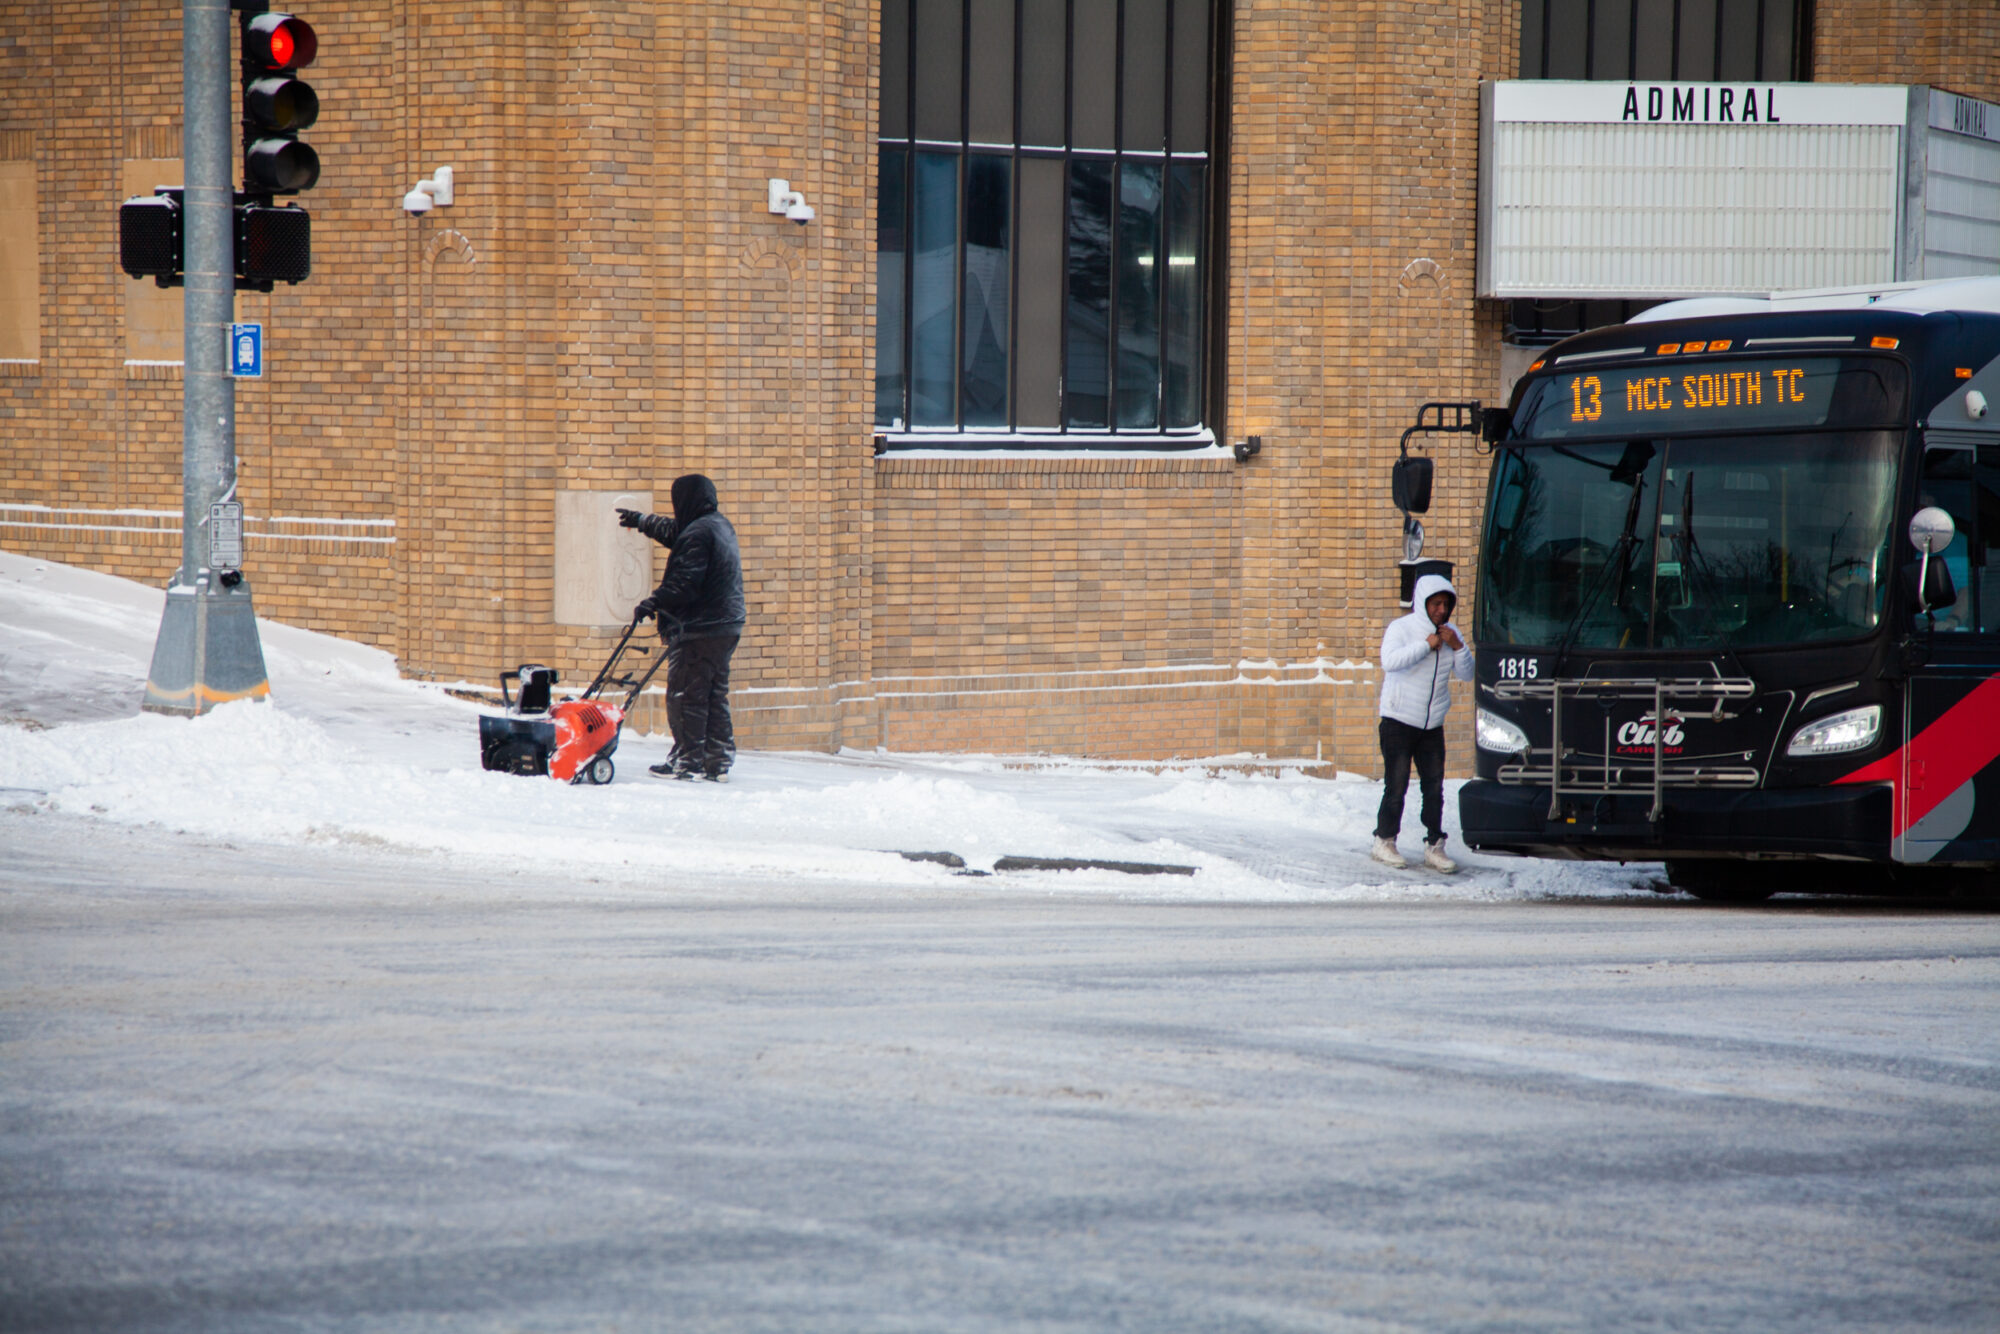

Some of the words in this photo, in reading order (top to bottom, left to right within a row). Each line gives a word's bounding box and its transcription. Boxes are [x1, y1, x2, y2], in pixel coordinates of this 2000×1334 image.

[1622, 86, 1780, 122] ADMIRAL
[1953, 96, 1987, 137] ADMIRAL
[1570, 376, 1602, 421] 13
[1627, 376, 1672, 411] MCC
[1682, 371, 1761, 408] SOUTH
[1772, 368, 1805, 402] TC
[1498, 657, 1538, 679] 1815
[1617, 721, 1685, 746] Club
[1616, 746, 1684, 754] CARWSH
